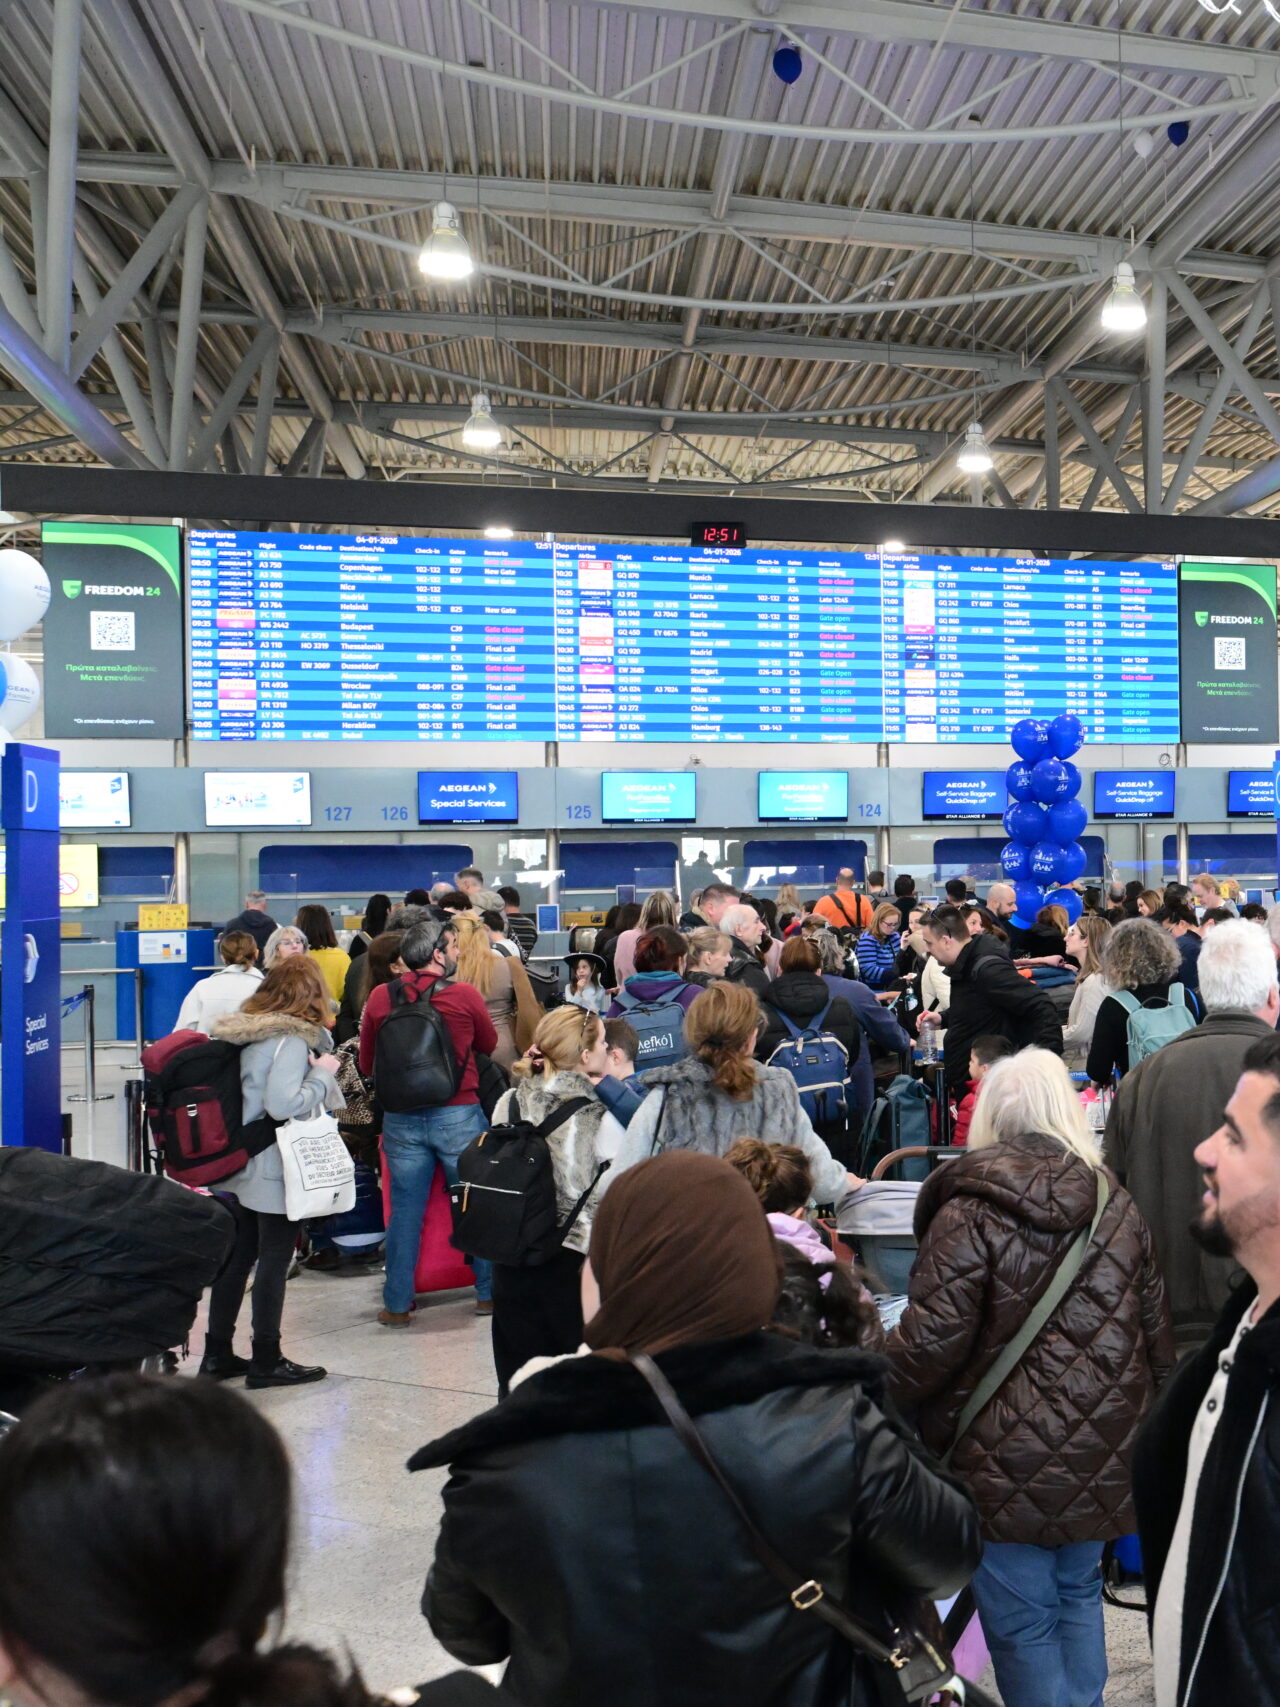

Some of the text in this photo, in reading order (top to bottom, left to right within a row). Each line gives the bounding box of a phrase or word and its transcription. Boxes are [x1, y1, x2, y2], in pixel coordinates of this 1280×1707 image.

[191, 530, 236, 539] Departures
[355, 536, 398, 545] 04-01-2026
[704, 528, 737, 541] 12:51
[556, 543, 596, 551] Departures
[883, 554, 919, 562] Departures
[85, 585, 161, 596] FREEDOM 24
[1210, 615, 1264, 625] FREEDOM 24
[25, 770, 39, 813] D
[621, 784, 667, 792] AEGEAN
[431, 799, 506, 808] Special Services
[325, 807, 352, 821] 127
[381, 807, 408, 821] 126
[566, 805, 592, 819] 125
[858, 804, 881, 817] 124
[25, 1013, 47, 1036] Special
[25, 1037, 49, 1056] Services
